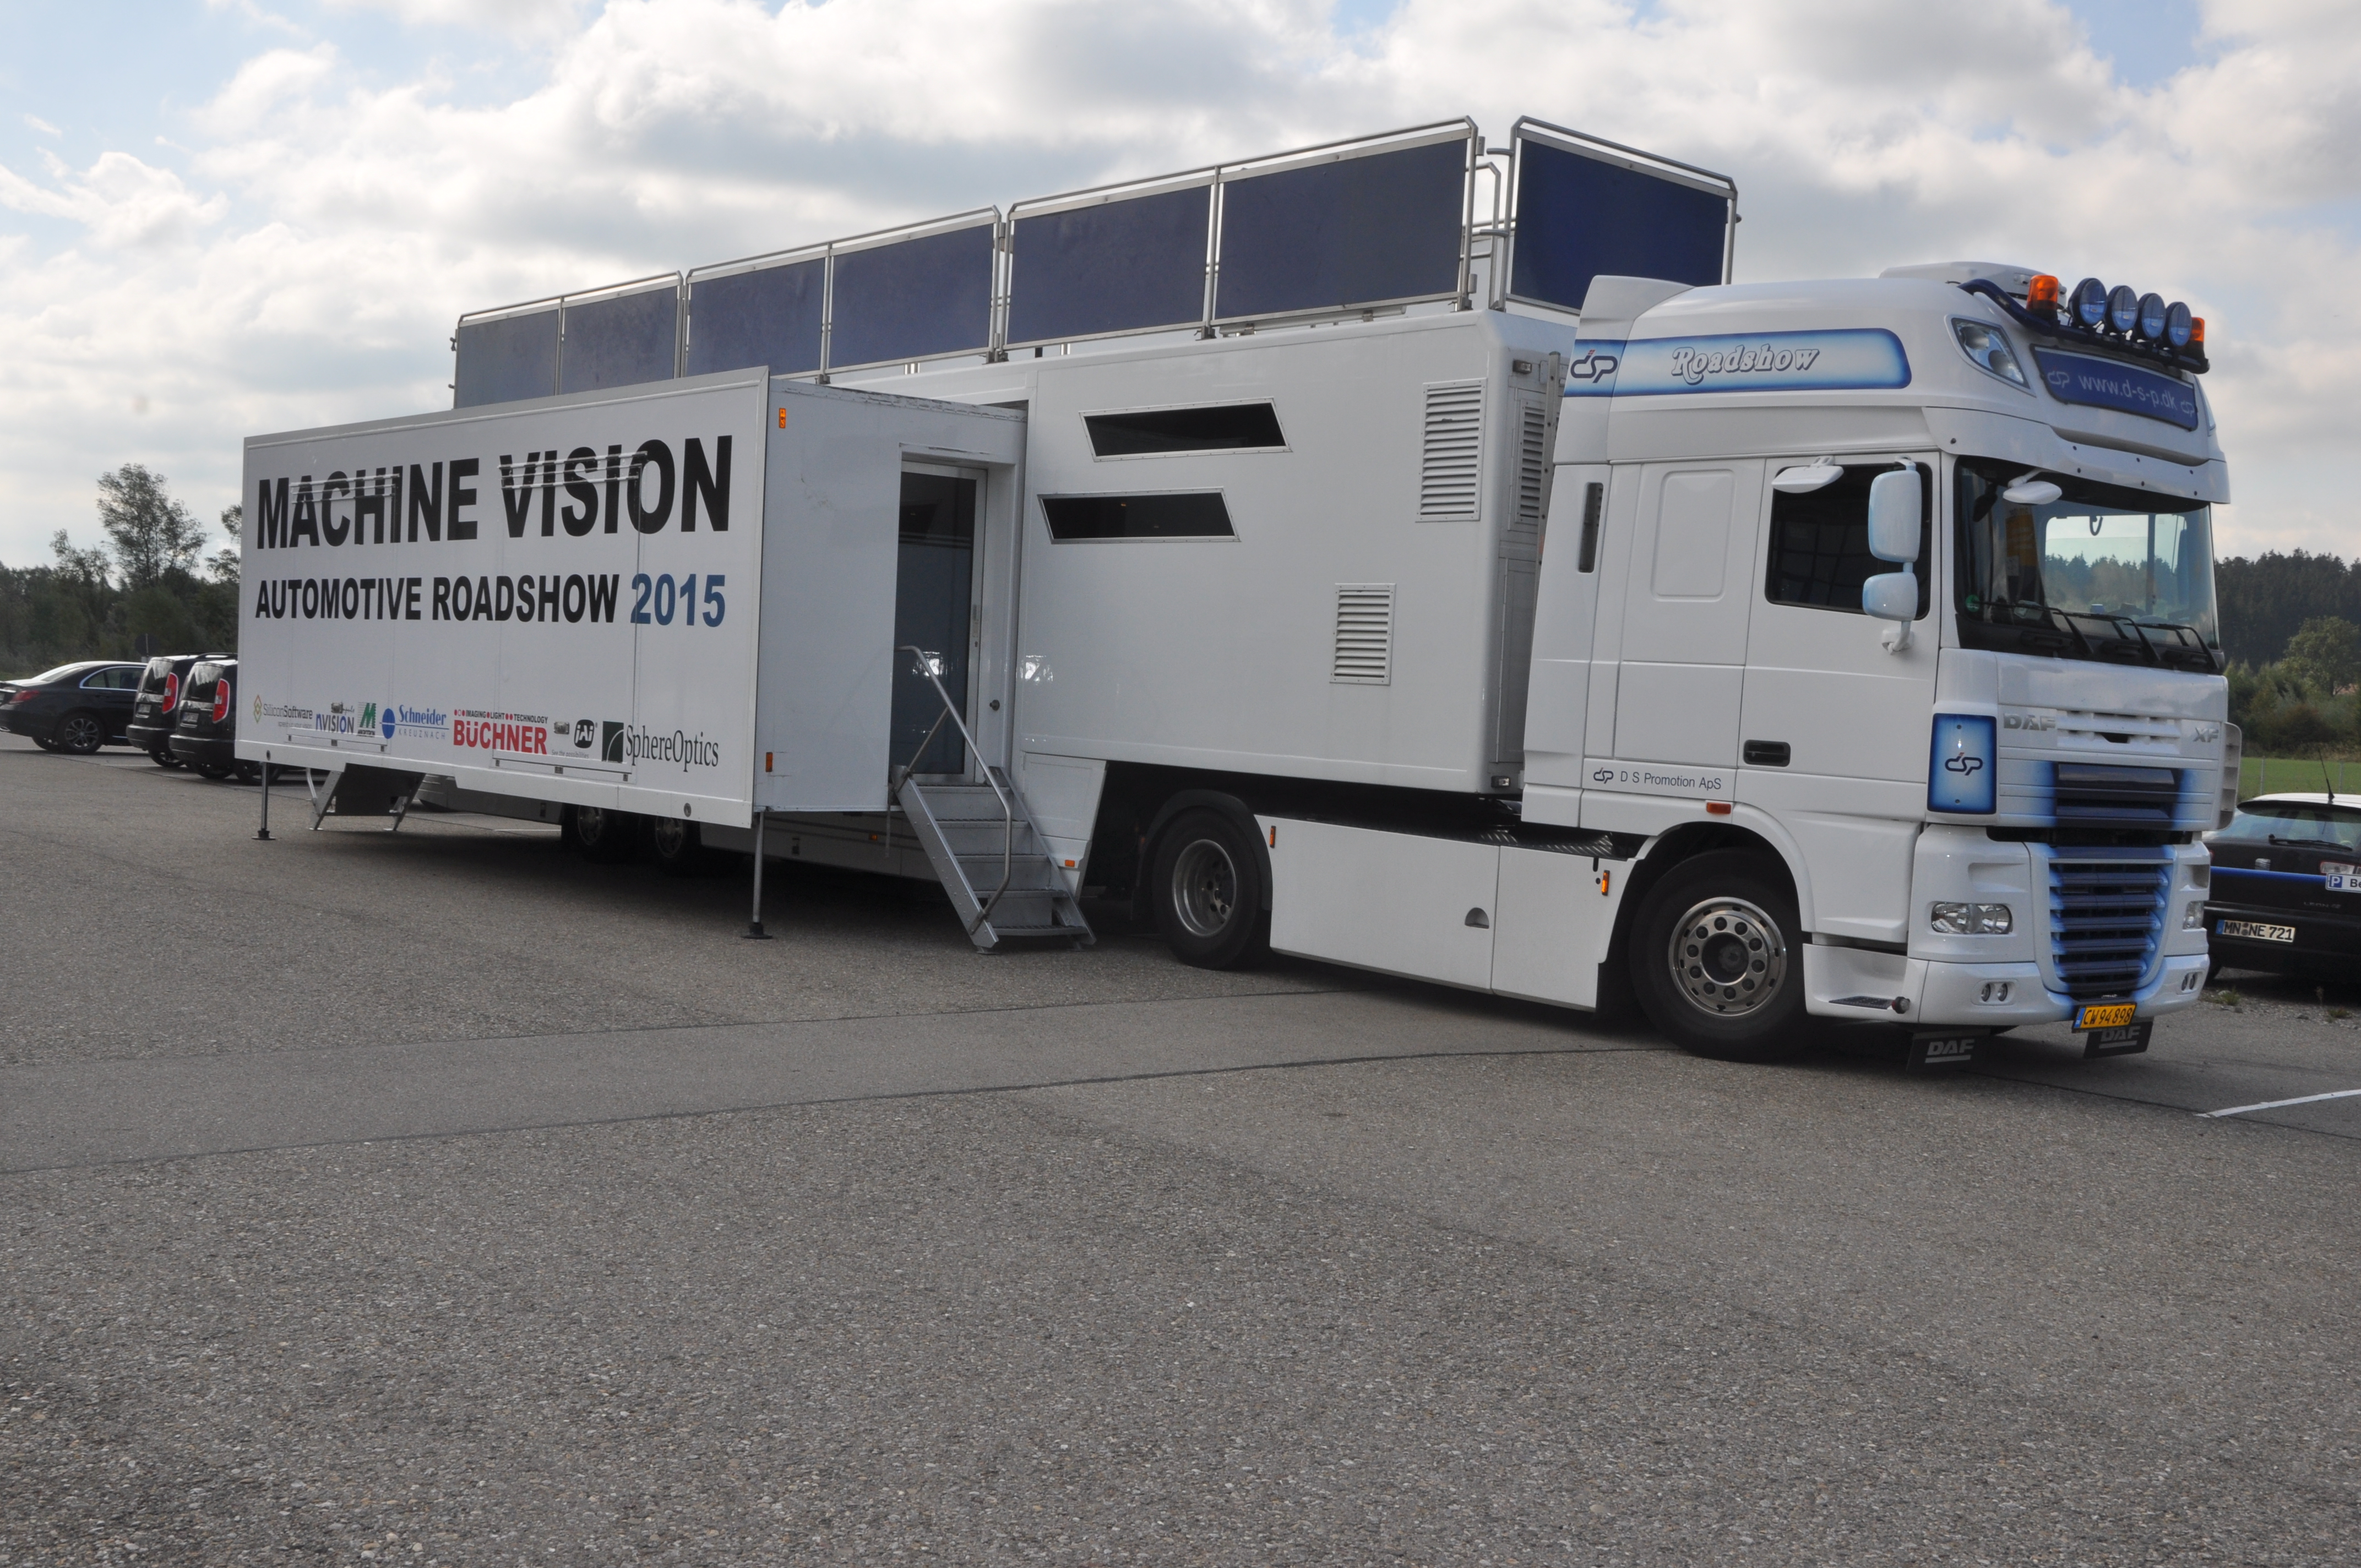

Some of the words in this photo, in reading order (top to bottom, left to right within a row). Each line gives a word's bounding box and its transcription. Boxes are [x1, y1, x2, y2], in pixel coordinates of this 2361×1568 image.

[1671, 344, 1821, 385] Roadshow
[2078, 374, 2177, 411] www.d-s-p.dk
[257, 458, 479, 549] MACHINE
[499, 435, 733, 538] VISION
[255, 578, 422, 620] AUTOMOTIVE
[433, 574, 620, 623] ROADSHOW
[630, 573, 726, 628] 2015
[399, 705, 447, 726] Schneider
[466, 710, 486, 718] IMAGING
[490, 712, 505, 720] LIGHT
[514, 714, 548, 724] TECHNOLOGY
[2003, 713, 2056, 731] DAF
[399, 728, 445, 739] KREUZNACH
[2193, 727, 2219, 743] XF
[625, 725, 719, 772] SphereOptics
[1620, 771, 1628, 782] D
[1632, 772, 1640, 783] S
[1644, 772, 1695, 788] Promotion
[1699, 777, 1722, 791] ApS
[2331, 876, 2341, 887] P
[2223, 921, 2242, 935] MN
[2248, 924, 2266, 937] NE
[2268, 926, 2292, 940] 721
[2101, 1026, 2141, 1042] DAF
[1928, 1038, 1975, 1055] DAF
